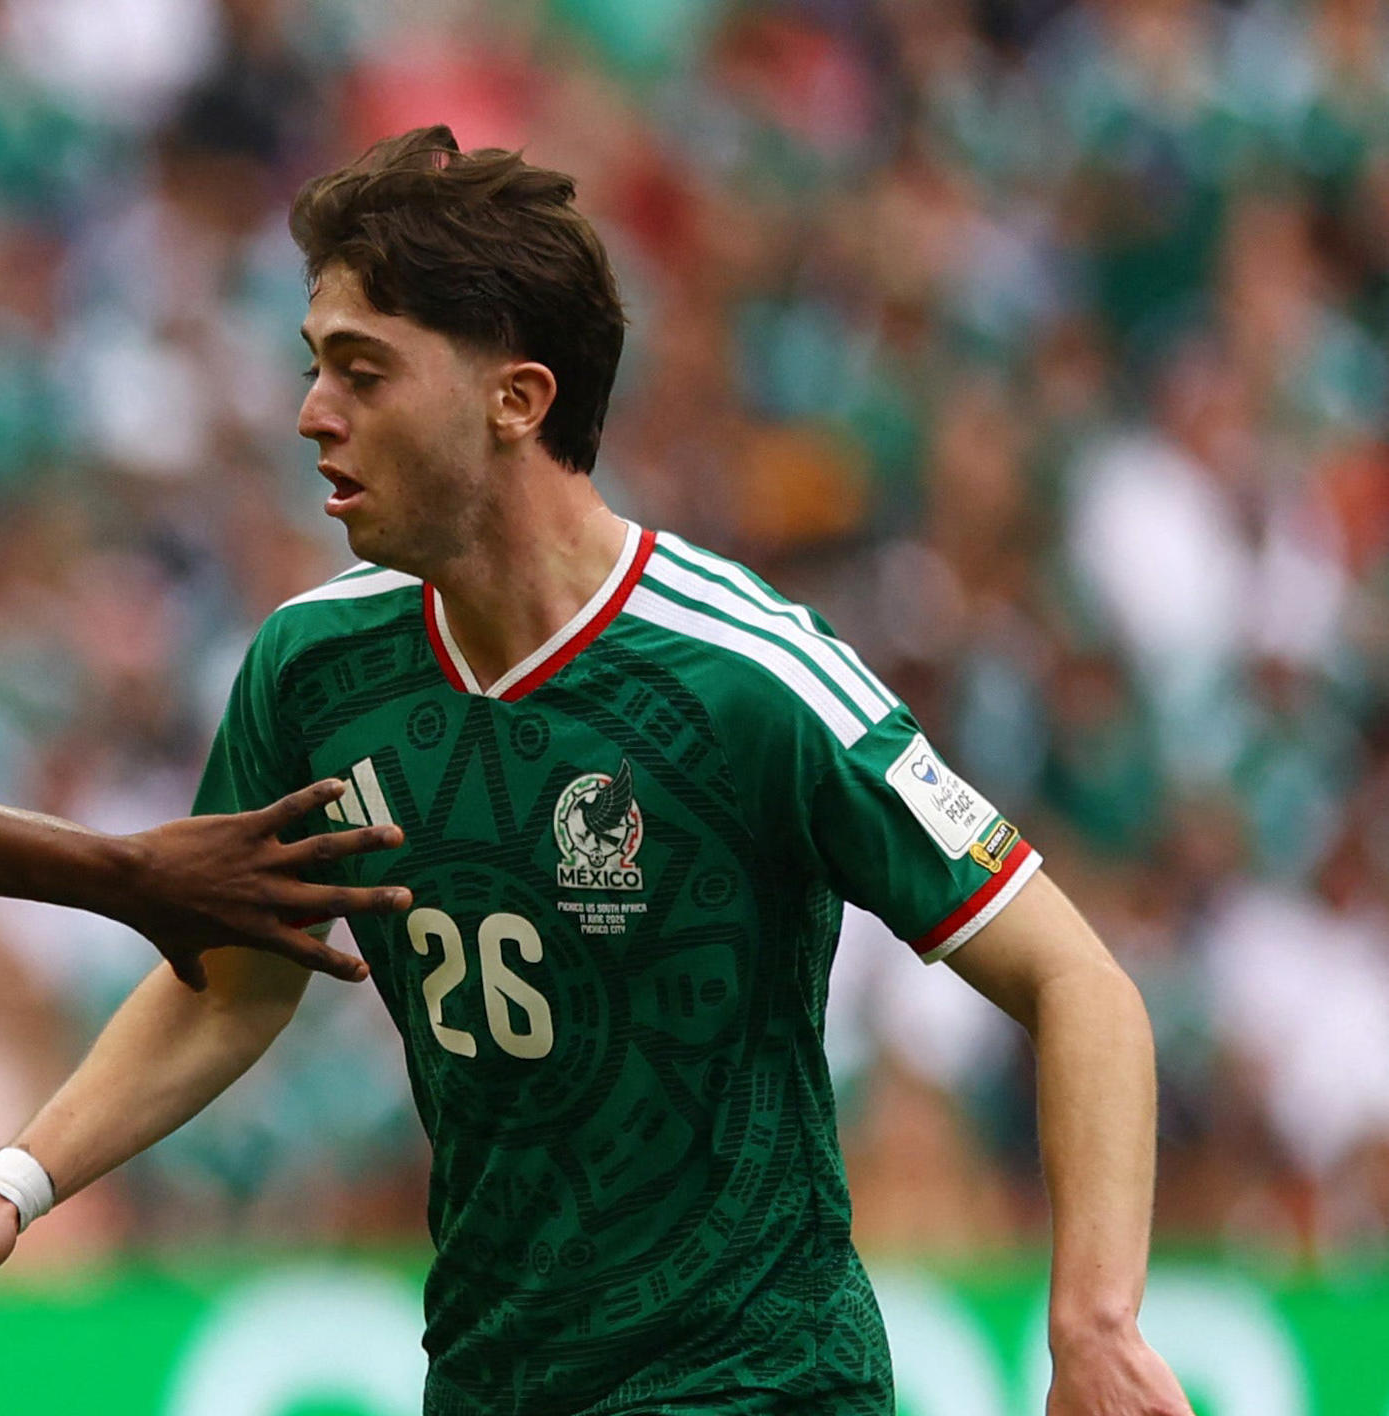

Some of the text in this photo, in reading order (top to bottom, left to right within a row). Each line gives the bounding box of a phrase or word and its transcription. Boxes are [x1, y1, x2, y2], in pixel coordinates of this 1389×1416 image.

[945, 790, 974, 825] PEACE
[559, 865, 640, 888] MÉXICO
[407, 907, 554, 1059] 26
